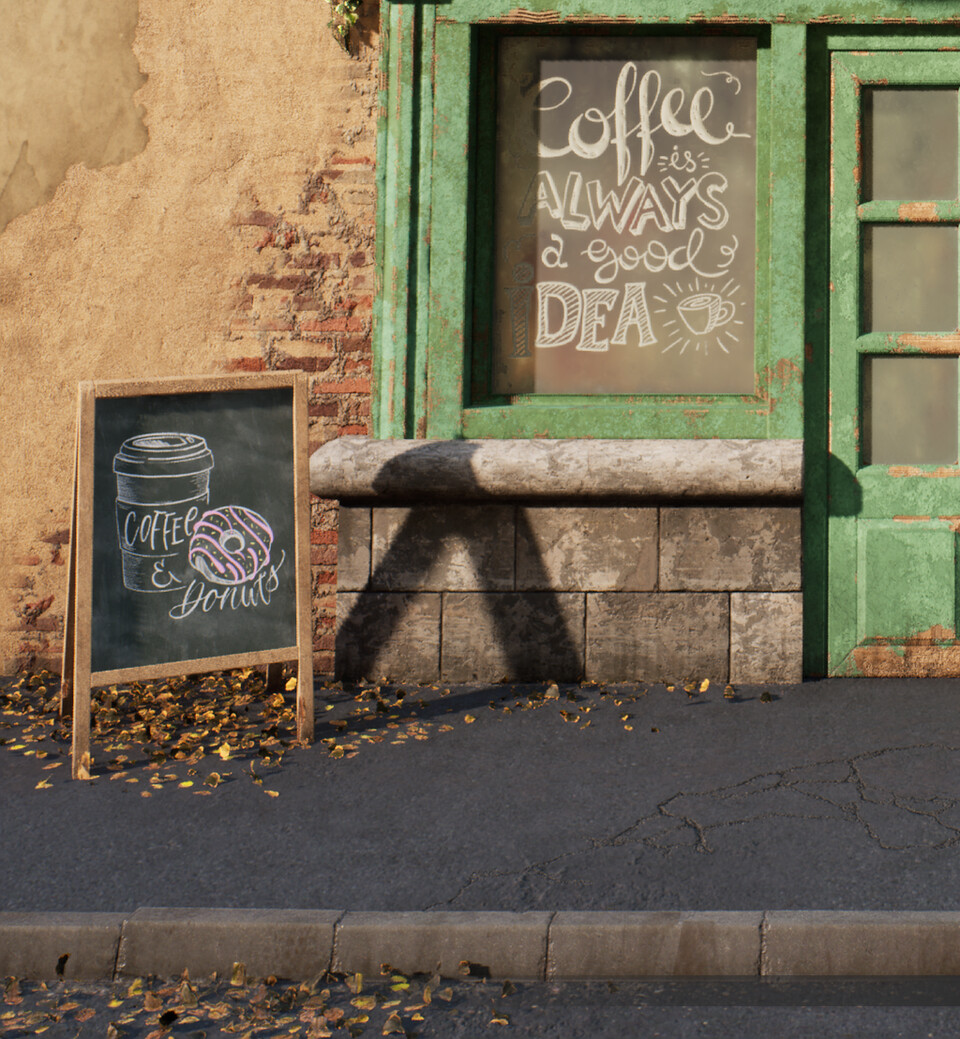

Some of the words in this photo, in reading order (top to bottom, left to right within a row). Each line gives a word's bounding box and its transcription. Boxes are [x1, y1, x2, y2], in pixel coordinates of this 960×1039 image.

[519, 61, 751, 186] Coffee
[670, 146, 698, 172] is
[518, 171, 729, 236] ALWAYS
[541, 234, 568, 268] a
[581, 228, 730, 285] good
[169, 549, 286, 619] Donuts
